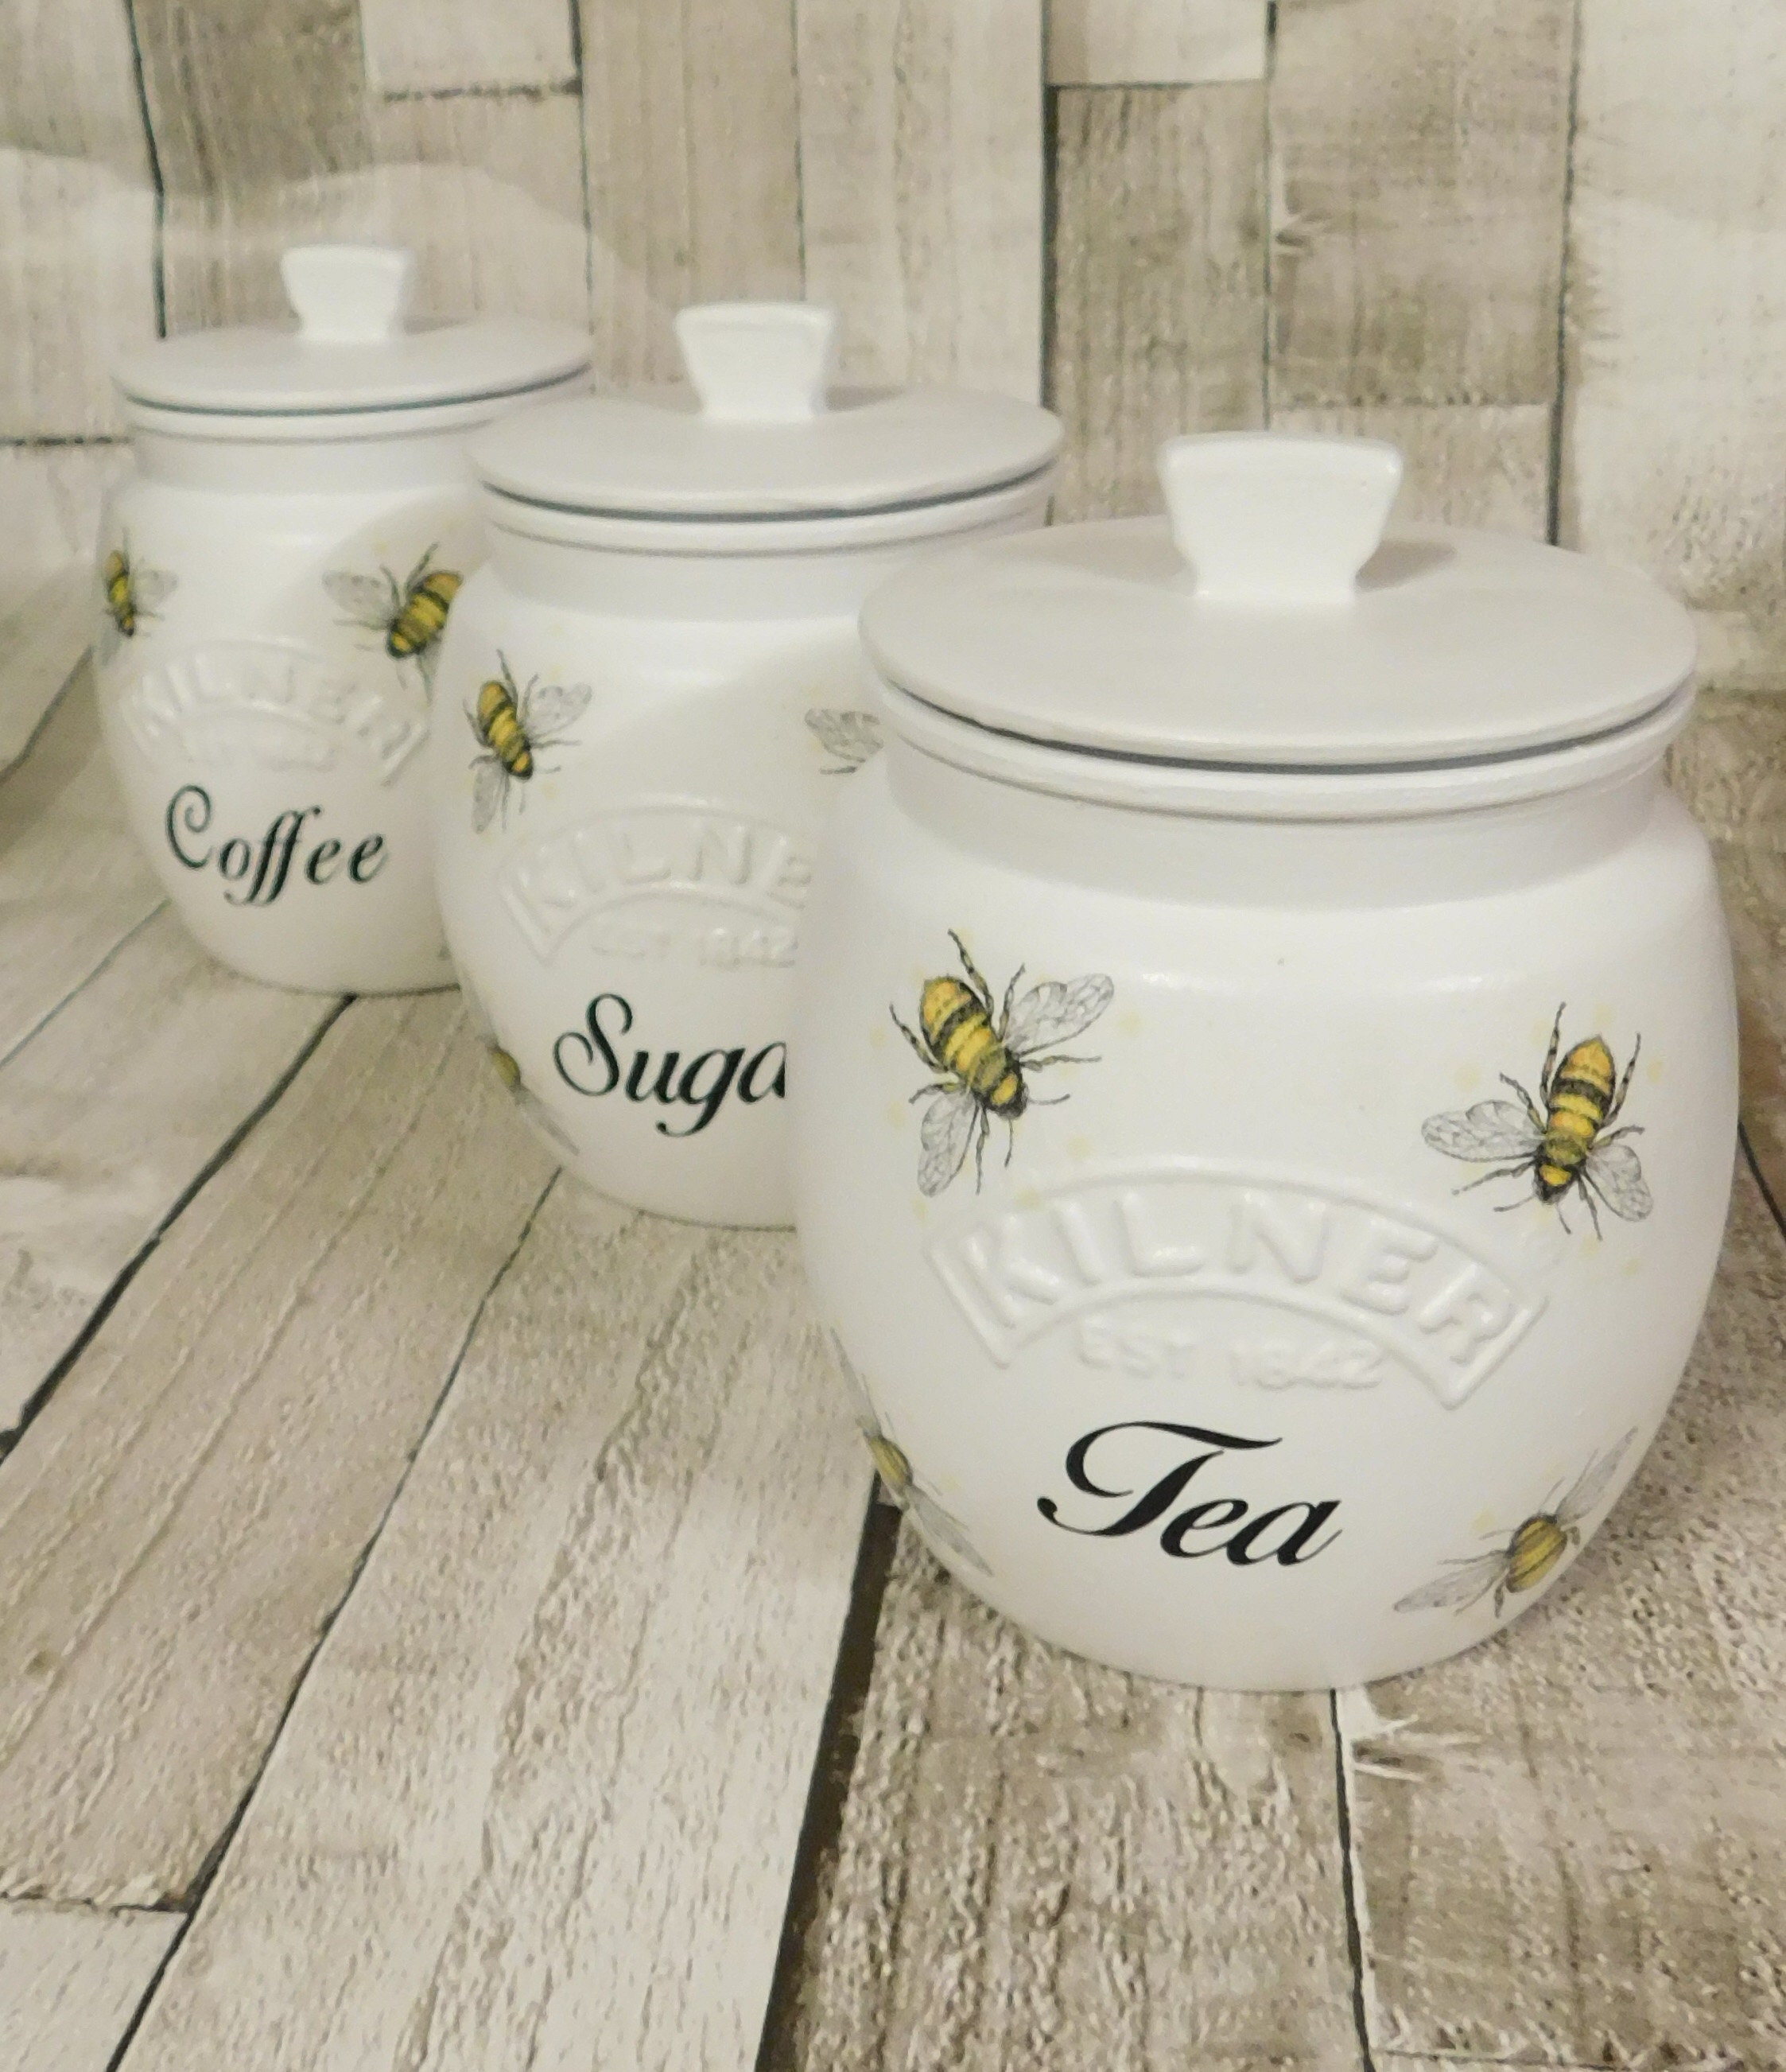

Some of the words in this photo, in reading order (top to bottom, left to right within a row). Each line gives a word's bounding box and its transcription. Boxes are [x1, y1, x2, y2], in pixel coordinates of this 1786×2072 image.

[165, 784, 390, 907] Coffee
[514, 818, 813, 935] KILNE
[553, 993, 787, 1137] Suga
[956, 1190, 1515, 1365] KILNER
[1077, 1316, 1198, 1379] EST
[1229, 1337, 1388, 1390] 1842
[1037, 1421, 1342, 1566] Tea
